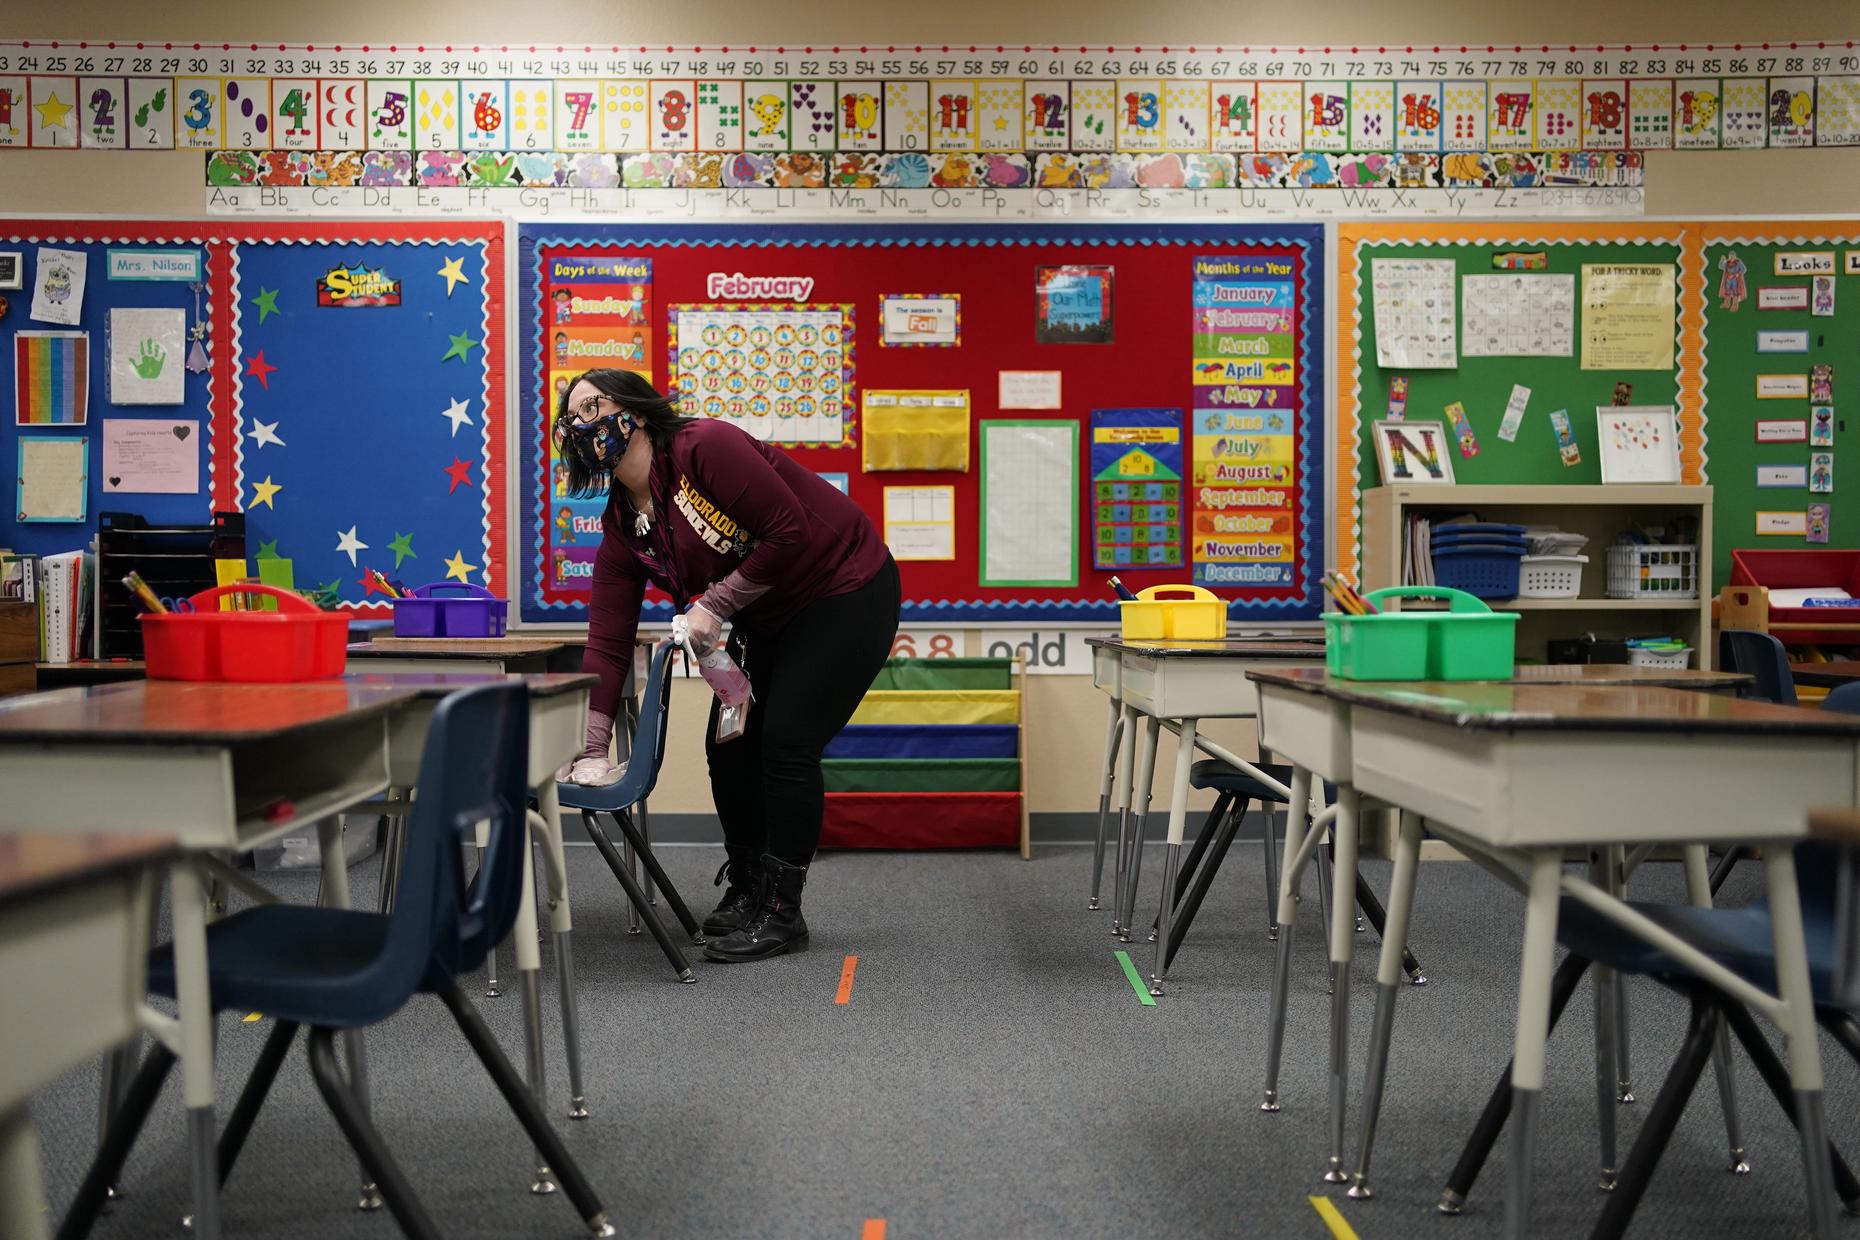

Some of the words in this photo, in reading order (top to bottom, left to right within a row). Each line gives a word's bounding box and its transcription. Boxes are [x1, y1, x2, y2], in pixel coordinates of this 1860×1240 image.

[17, 56, 39, 72] 24
[45, 56, 67, 72] 25
[74, 56, 95, 72] 26
[104, 57, 125, 73] 27
[132, 57, 153, 73] 28
[159, 58, 181, 74] 29
[187, 58, 208, 73] 30
[246, 59, 266, 74] 32
[273, 59, 294, 75] 33
[328, 60, 350, 75] 35
[357, 60, 378, 75] 36
[385, 60, 406, 75] 37
[412, 61, 432, 75] 38
[660, 61, 681, 75] 47
[688, 61, 709, 75] 48
[716, 61, 736, 75] 49
[742, 61, 764, 76] 50
[773, 61, 789, 76] 51
[799, 60, 820, 76] 52
[827, 60, 848, 76] 53
[854, 60, 876, 75] 54
[880, 60, 902, 75] 55
[908, 60, 929, 75] 56
[935, 60, 957, 76] 57
[962, 60, 984, 75] 58
[990, 60, 1010, 75] 59
[1018, 59, 1039, 75] 60
[1048, 60, 1064, 75] 61
[1073, 60, 1094, 75] 62
[1101, 60, 1122, 76] 63
[1345, 61, 1366, 77] 72
[1373, 61, 1393, 76] 73
[1400, 61, 1420, 76] 74
[1427, 61, 1448, 76] 75
[1455, 60, 1475, 76] 76
[1481, 60, 1503, 76] 77
[1508, 60, 1528, 76] 78
[1536, 60, 1557, 76] 79
[1564, 60, 1584, 75] 80
[1593, 60, 1608, 76] 81
[1618, 60, 1639, 75] 82
[1646, 59, 1667, 75] 83
[1674, 59, 1696, 74] 84
[1701, 58, 1722, 74] 85
[1729, 57, 1749, 74] 86
[1756, 57, 1777, 73] 87
[97, 136, 114, 144] two
[148, 129, 158, 144] 2
[189, 138, 213, 147] three
[242, 132, 252, 147] 3
[284, 138, 304, 147] four
[338, 132, 348, 146] 4
[382, 140, 399, 148] five
[431, 133, 441, 148] 5
[526, 133, 536, 148] 6
[715, 133, 725, 148] 8
[808, 134, 818, 149] 9
[899, 134, 917, 149] 10
[1586, 139, 1622, 149] eighteen
[1679, 138, 1715, 147] nineteen
[1776, 136, 1807, 146] twenty
[117, 259, 146, 272] Mrs.
[152, 259, 192, 272] Nilson
[555, 263, 585, 279] Days
[614, 264, 648, 277] Week
[1197, 262, 1240, 274] Months
[1243, 265, 1251, 273] of
[1253, 265, 1264, 273] the
[1266, 262, 1292, 275] Year
[1592, 267, 1605, 276] FOR
[1613, 267, 1638, 276] TRICKY
[709, 274, 812, 300] February
[1213, 285, 1275, 304] January
[1053, 291, 1073, 306] Our
[571, 296, 633, 318] Sunday
[910, 315, 937, 332] Fall
[1207, 310, 1280, 331] February
[733, 331, 739, 341] 2
[828, 332, 836, 342] 6
[568, 339, 636, 361] Monday
[1219, 337, 1270, 354] March
[754, 355, 765, 365] 10
[803, 356, 814, 366] 12
[826, 356, 837, 366] 13
[1225, 362, 1264, 380] April
[731, 378, 742, 388] 16
[778, 378, 790, 388] 18
[801, 378, 812, 388] 19
[824, 379, 836, 389] 20
[1224, 386, 1262, 407] May
[708, 402, 720, 412] 22
[753, 401, 765, 411] 24
[780, 402, 792, 412] 25
[1225, 414, 1263, 430] June
[1226, 439, 1261, 459] July
[1385, 430, 1444, 478] N
[1132, 454, 1142, 464] 10
[1216, 464, 1271, 484] August
[1133, 486, 1141, 497] 2
[1165, 487, 1177, 497] 10
[1201, 488, 1285, 509] September
[673, 489, 733, 554] SUNDEVILS
[1214, 515, 1273, 532] October
[1101, 529, 1112, 541] 10
[1167, 528, 1175, 539] 2
[1206, 542, 1282, 557] November
[1205, 564, 1281, 582] December
[988, 632, 1066, 667] odd
